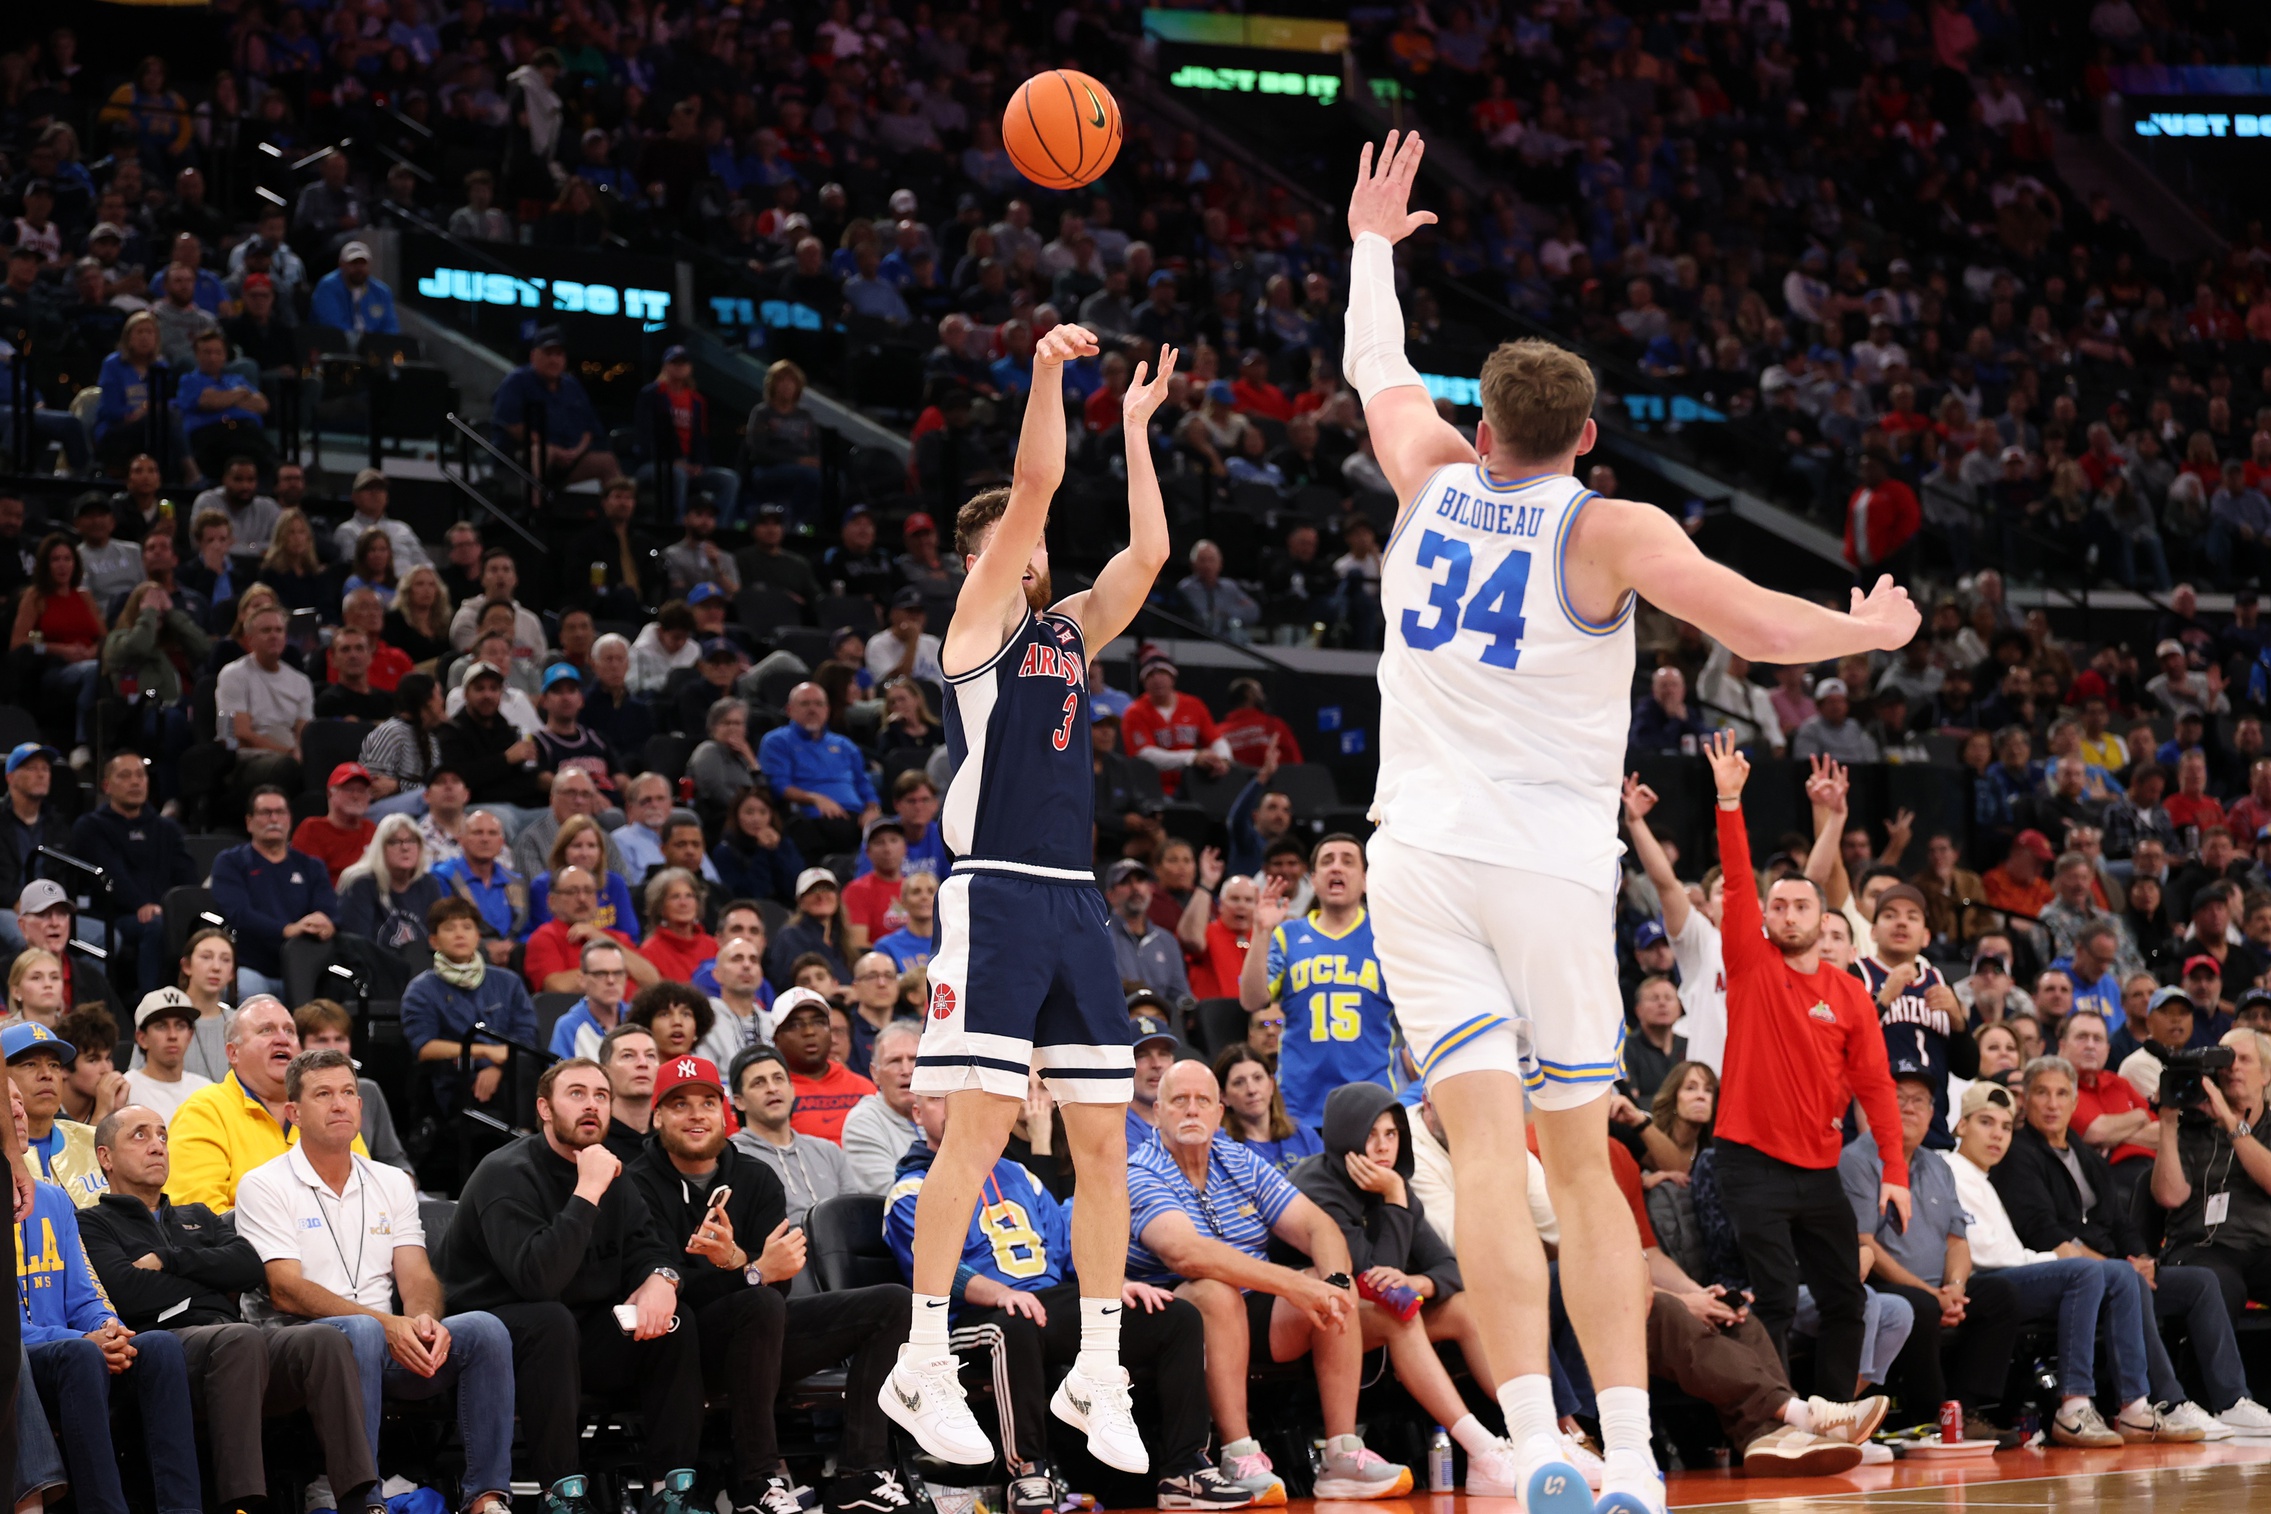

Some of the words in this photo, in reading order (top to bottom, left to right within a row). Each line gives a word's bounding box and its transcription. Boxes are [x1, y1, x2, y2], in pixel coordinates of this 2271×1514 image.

[2134, 113, 2230, 137] JUST
[418, 267, 546, 308] JUST
[624, 288, 671, 321] IT
[1436, 486, 1544, 538] BILODEAU
[1400, 528, 1531, 670] 34
[1052, 692, 1078, 751] 3
[164, 993, 180, 1005] W
[1290, 954, 1380, 995] UCLA
[1309, 992, 1362, 1043] 15
[677, 1059, 697, 1078] NY
[1914, 1028, 1930, 1067] 1
[14, 1217, 65, 1277] LA
[978, 1199, 1047, 1279] 8
